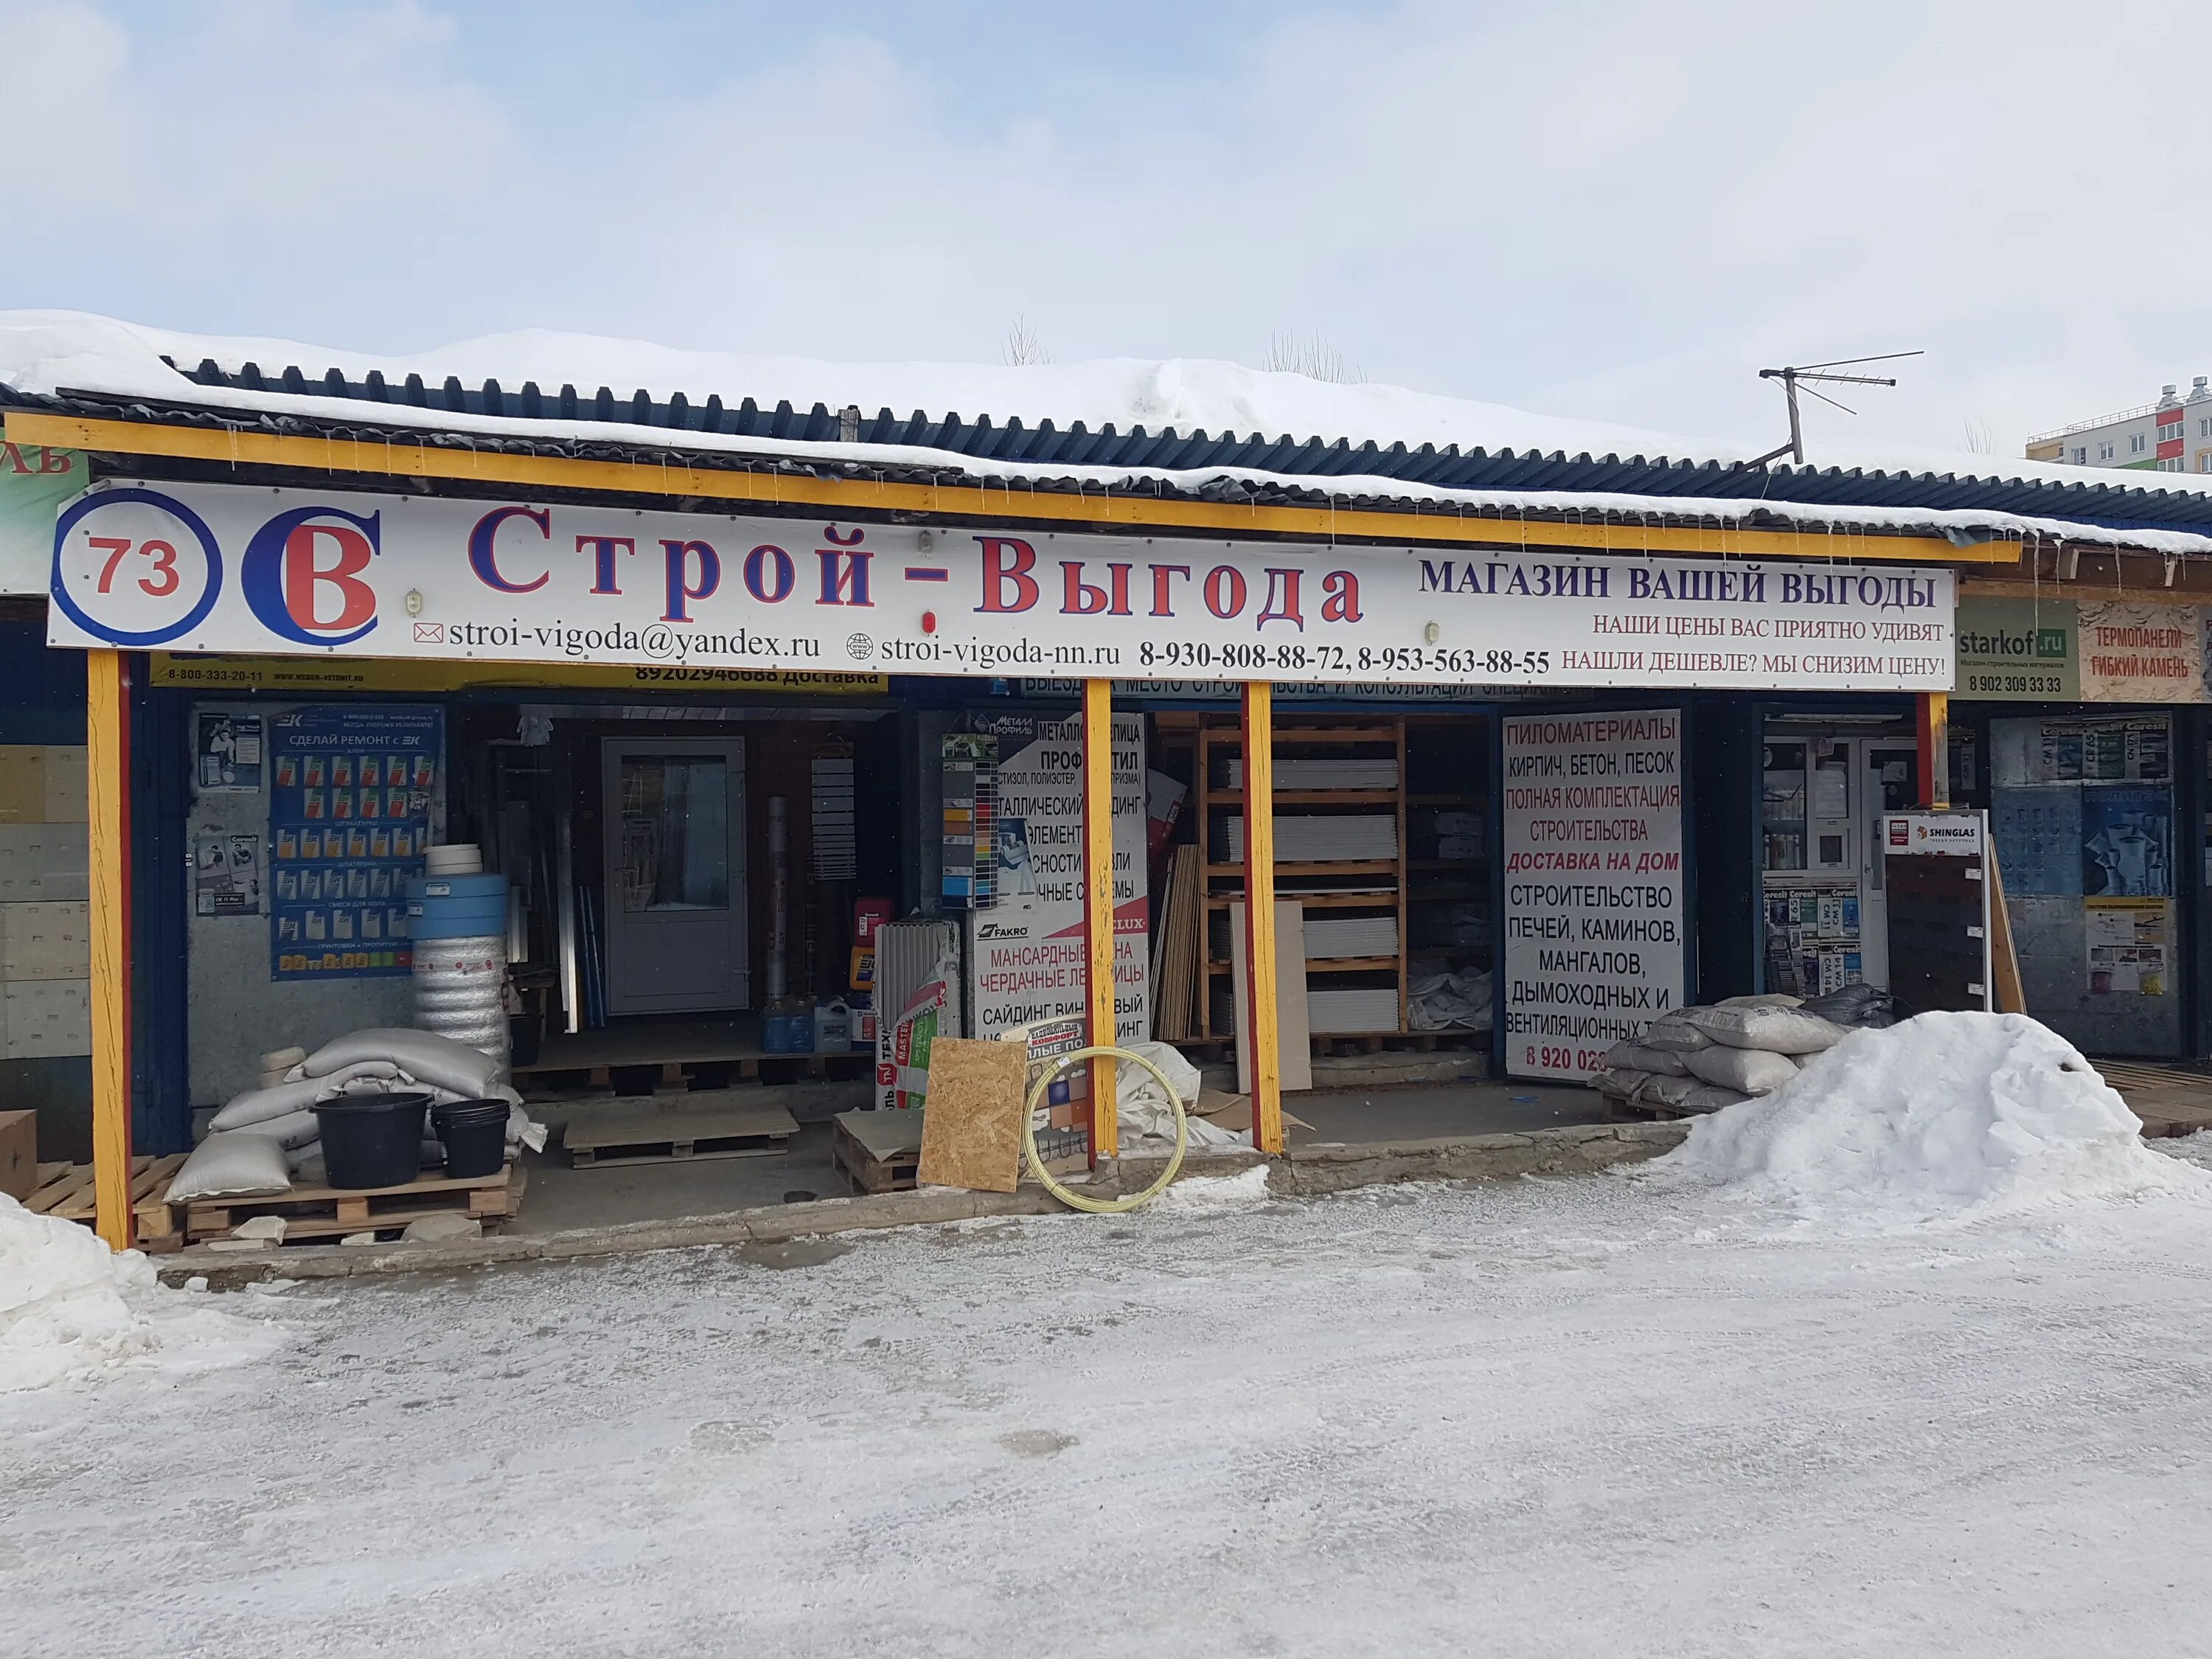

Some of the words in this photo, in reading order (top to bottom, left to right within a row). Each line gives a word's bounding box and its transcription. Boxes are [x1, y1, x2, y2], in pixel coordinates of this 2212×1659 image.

[88, 537, 180, 597] 73
[467, 506, 875, 622] Строй
[973, 535, 1364, 632] Выгода
[1419, 560, 1610, 598] МАГАЗИН
[1628, 564, 1767, 603] ВАШЕЙ
[1780, 573, 1937, 613] ВЫГОДЫ
[449, 618, 821, 658] stroi-vigoda@yandex.ru
[1593, 614, 1660, 636] НАШИ
[1665, 616, 1727, 639] ЦЕНЫ
[1731, 619, 1769, 639] ВАС
[1774, 619, 1866, 640] ПРИЯТНО
[1871, 622, 1944, 644] УДИВЯТ
[2096, 627, 2182, 649] ТЕРМОПАНЕЛИ
[880, 635, 1121, 668] stroi-vigoda-nn.ru
[169, 669, 263, 681] 8-800-333-20-11
[1562, 650, 1644, 670] НАШЛИ
[1649, 651, 1757, 674] ДЕШЕВЛЕ?
[1762, 655, 1798, 672] МЫ
[1803, 656, 1884, 674] СНИЗИМ
[1888, 658, 1947, 678] ЦЕНУ!
[2092, 654, 2140, 677] ГИБКИЙ
[2142, 656, 2188, 677] КАМЕНЬ
[1969, 676, 1977, 691] 8
[1980, 676, 2002, 692] 902
[2005, 676, 2026, 692] 309
[2029, 677, 2043, 692] 33
[2047, 677, 2062, 692] 33
[289, 734, 338, 746] СДЕЛАЙ
[341, 736, 390, 745] РЕМОНТ
[989, 723, 1033, 735] ПРОФИЛЬ
[1507, 717, 1675, 745] ПИЛОМАТЕРИАЛЫ
[1509, 754, 1566, 779] КИРПИЧ,
[1571, 753, 1621, 777] БЕТОН,
[1625, 751, 1674, 774] ПЕСОК
[1031, 773, 1077, 787] ПОЛИЭСТЕР,
[1506, 787, 1561, 810] ПОЛНАЯ
[1565, 785, 1680, 812] КОМПЛЕКТАЦИЯ
[1530, 819, 1649, 841] СТРОИТЕЛЬСТВА
[1929, 828, 1975, 837] SHINGLAS
[1506, 852, 1601, 873] ДОСТАВКА
[1607, 852, 1631, 870] НА
[1635, 852, 1680, 874] ДОМ
[1511, 885, 1672, 908] СТРОИТЕЛЬСТВО
[1790, 889, 1818, 898] Ceresit
[995, 927, 1029, 938] FAKRO
[1509, 914, 1576, 942] ПЕЧЕЙ,
[1582, 919, 1681, 946] КАМИНОВ,
[1539, 949, 1646, 978] МАНГАЛОВ,
[980, 969, 1066, 995] ЧЕРДАЧНЫЕ
[1512, 980, 1650, 1011] ДЫМОХОДНЫХ
[1656, 988, 1669, 1009] И
[983, 1004, 1051, 1026] САЙДИНГ
[1032, 1030, 1079, 1046] КОМФОРТ
[1506, 1012, 1641, 1042] ВЕНТИЛЯЦИОННЫХ
[1526, 1046, 1536, 1066] 8
[1541, 1046, 1571, 1069] 920
